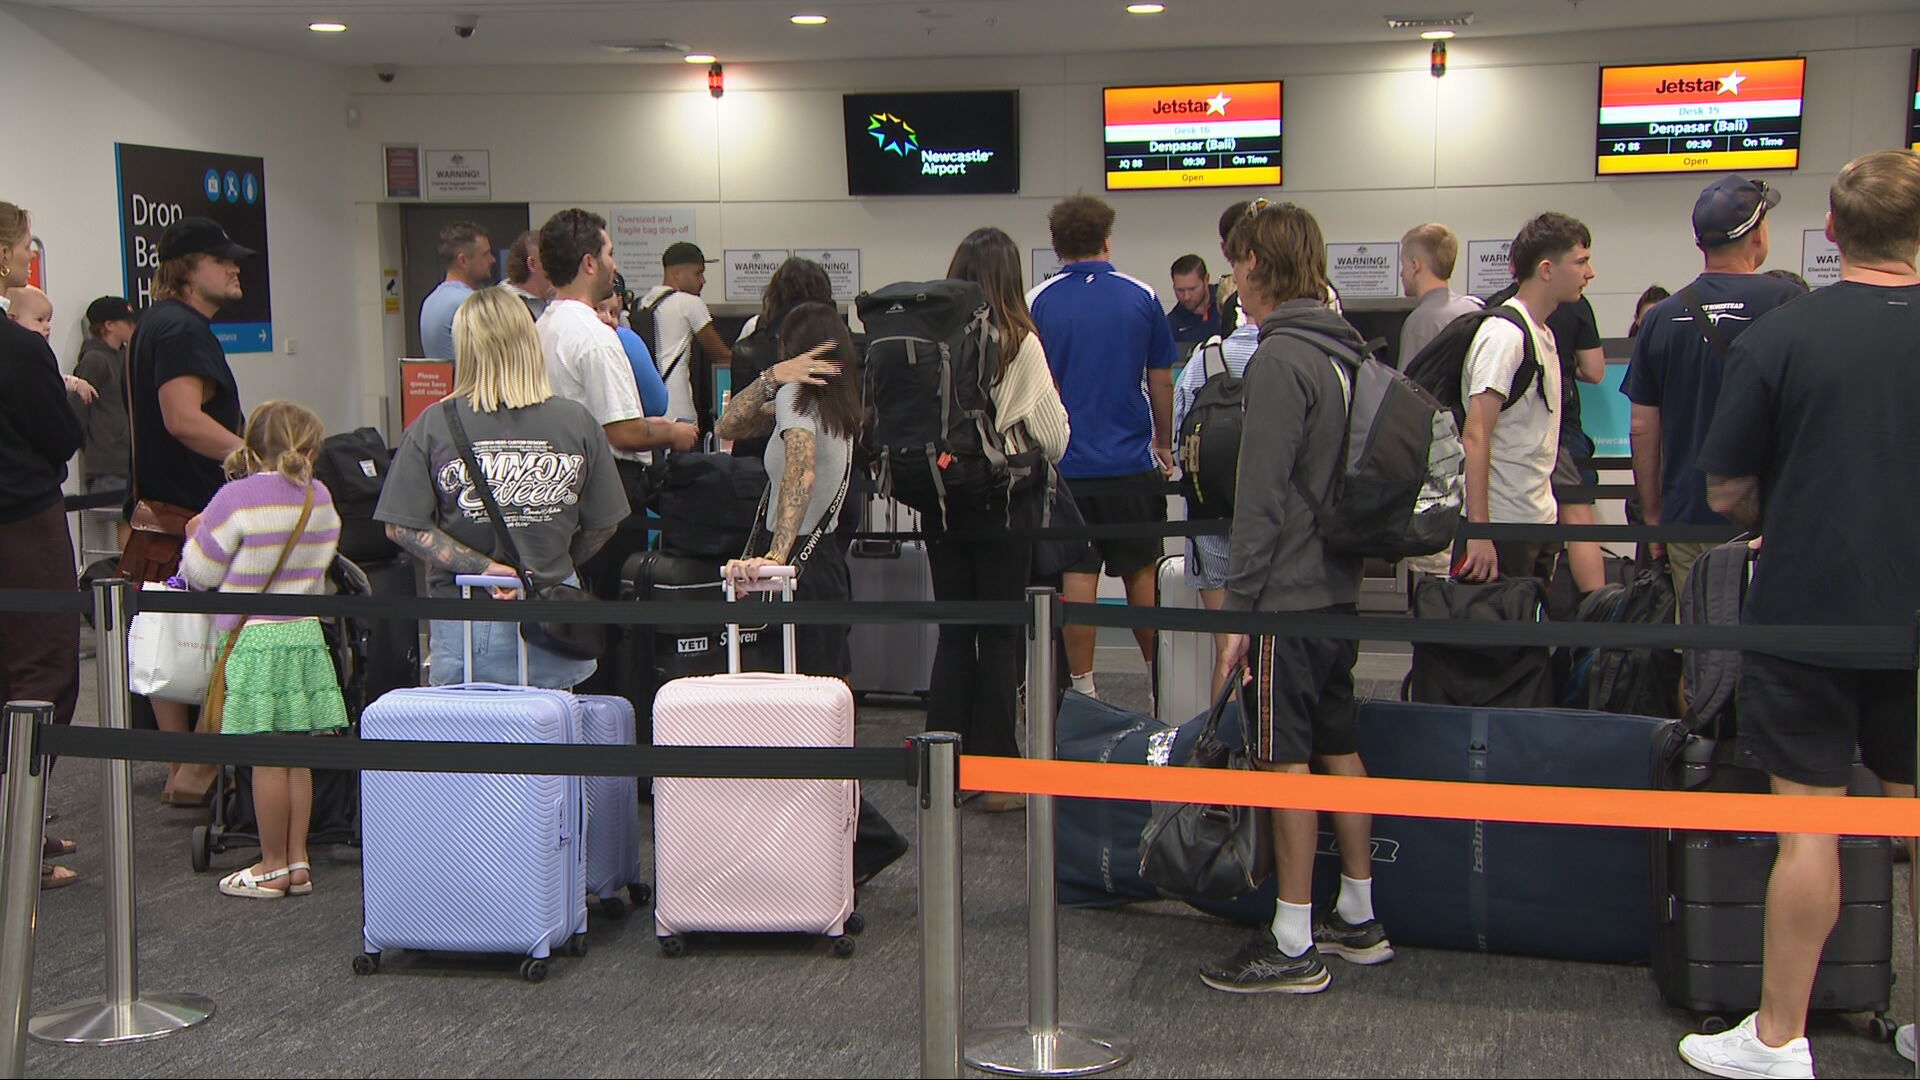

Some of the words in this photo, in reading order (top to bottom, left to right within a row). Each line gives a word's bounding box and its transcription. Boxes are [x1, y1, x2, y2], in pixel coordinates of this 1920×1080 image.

[1656, 78, 1721, 94] Jetstar
[1153, 99, 1209, 114] Jetstar
[1679, 107, 1704, 116] Desk
[1649, 122, 1711, 136] Denpasar
[1713, 119, 1749, 134] (Bali)
[1150, 141, 1204, 154] Denpasar
[1206, 138, 1237, 152] (Bali)
[1685, 140, 1712, 149] 09:30
[1742, 138, 1758, 148] On
[1759, 136, 1784, 146] Time
[1612, 143, 1626, 152] JQ
[921, 150, 989, 163] Newcastle
[1232, 156, 1246, 165] On
[1247, 155, 1268, 165] Time
[1119, 160, 1130, 169] JQ
[1182, 157, 1206, 167] 09:30
[1683, 157, 1708, 167] Open
[921, 162, 966, 176] Airport
[436, 170, 480, 179] WARNING!
[1181, 174, 1204, 183] Open
[618, 227, 641, 235] fragile
[643, 226, 657, 235] bag
[659, 226, 688, 235] drop-off
[135, 236, 160, 268] Ba
[1337, 257, 1387, 265] WARNING!
[431, 380, 446, 388] here
[800, 527, 824, 561] MIMCO
[679, 639, 706, 651] YETI
